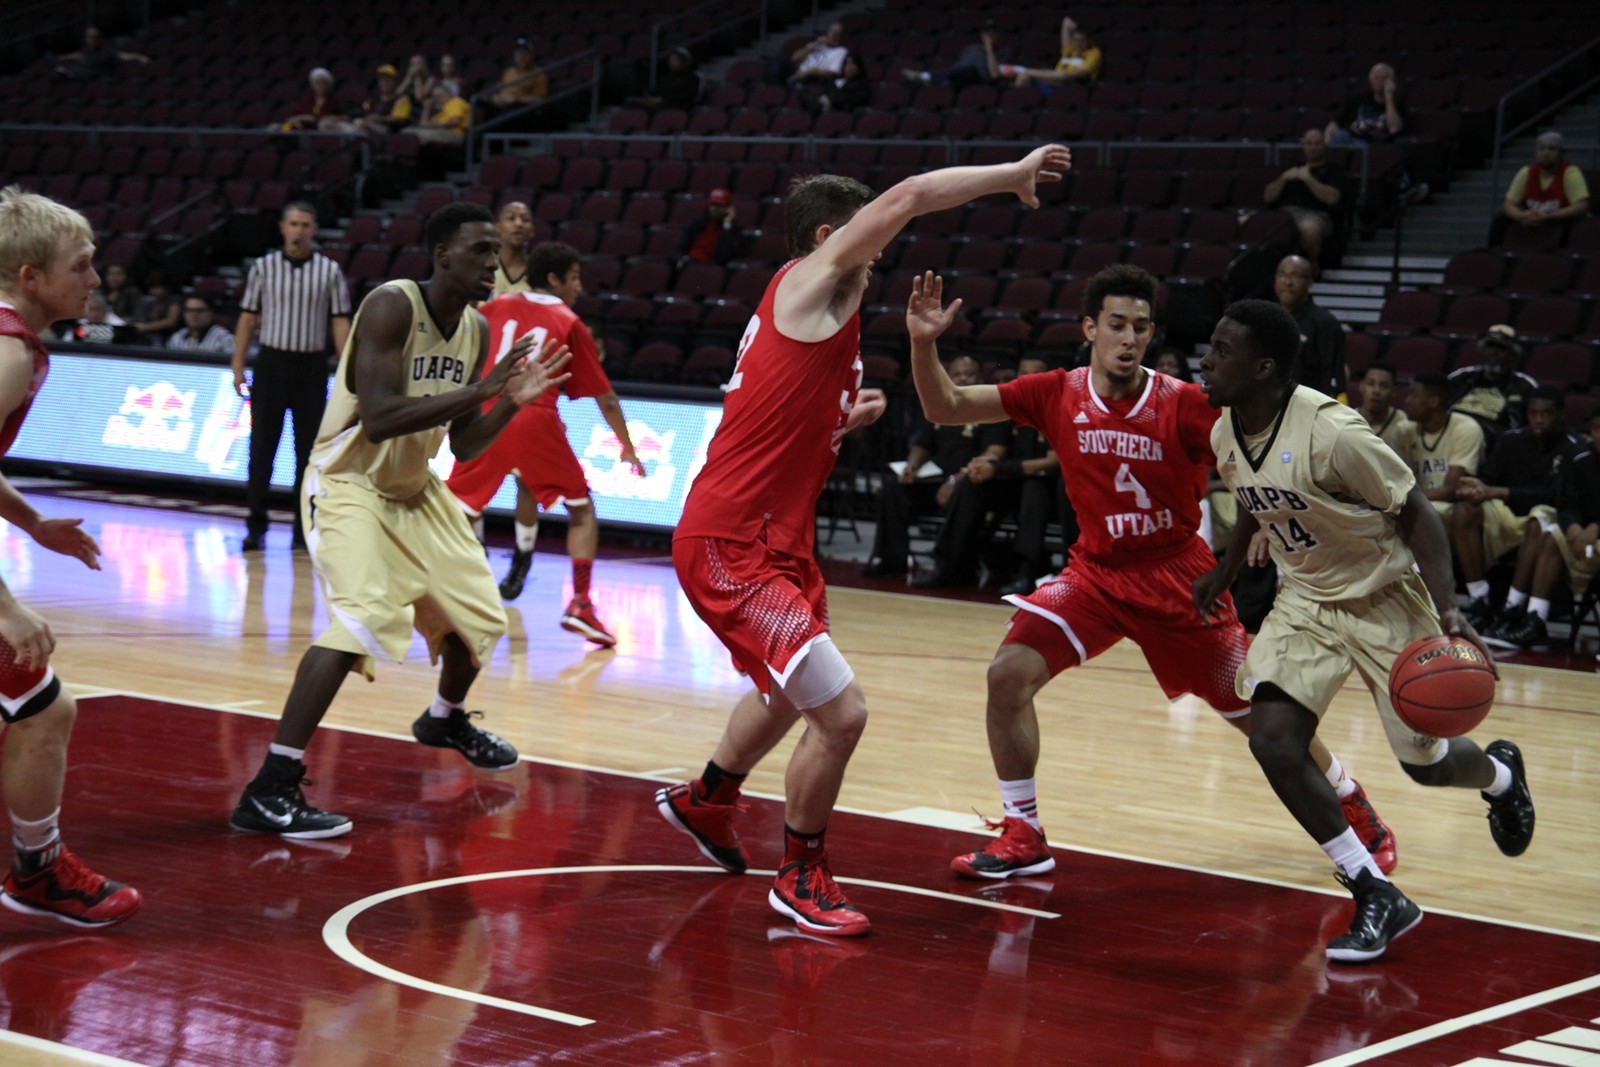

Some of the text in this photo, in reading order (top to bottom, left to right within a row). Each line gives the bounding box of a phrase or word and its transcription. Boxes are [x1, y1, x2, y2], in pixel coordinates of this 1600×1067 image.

[413, 355, 464, 385] UAPB
[1077, 429, 1163, 461] SOUTHERN
[1114, 462, 1152, 509] 4
[1236, 486, 1310, 512] UAPB
[1105, 508, 1173, 539] UTAH
[1268, 516, 1318, 553] 14
[1416, 644, 1485, 667] Wilson
